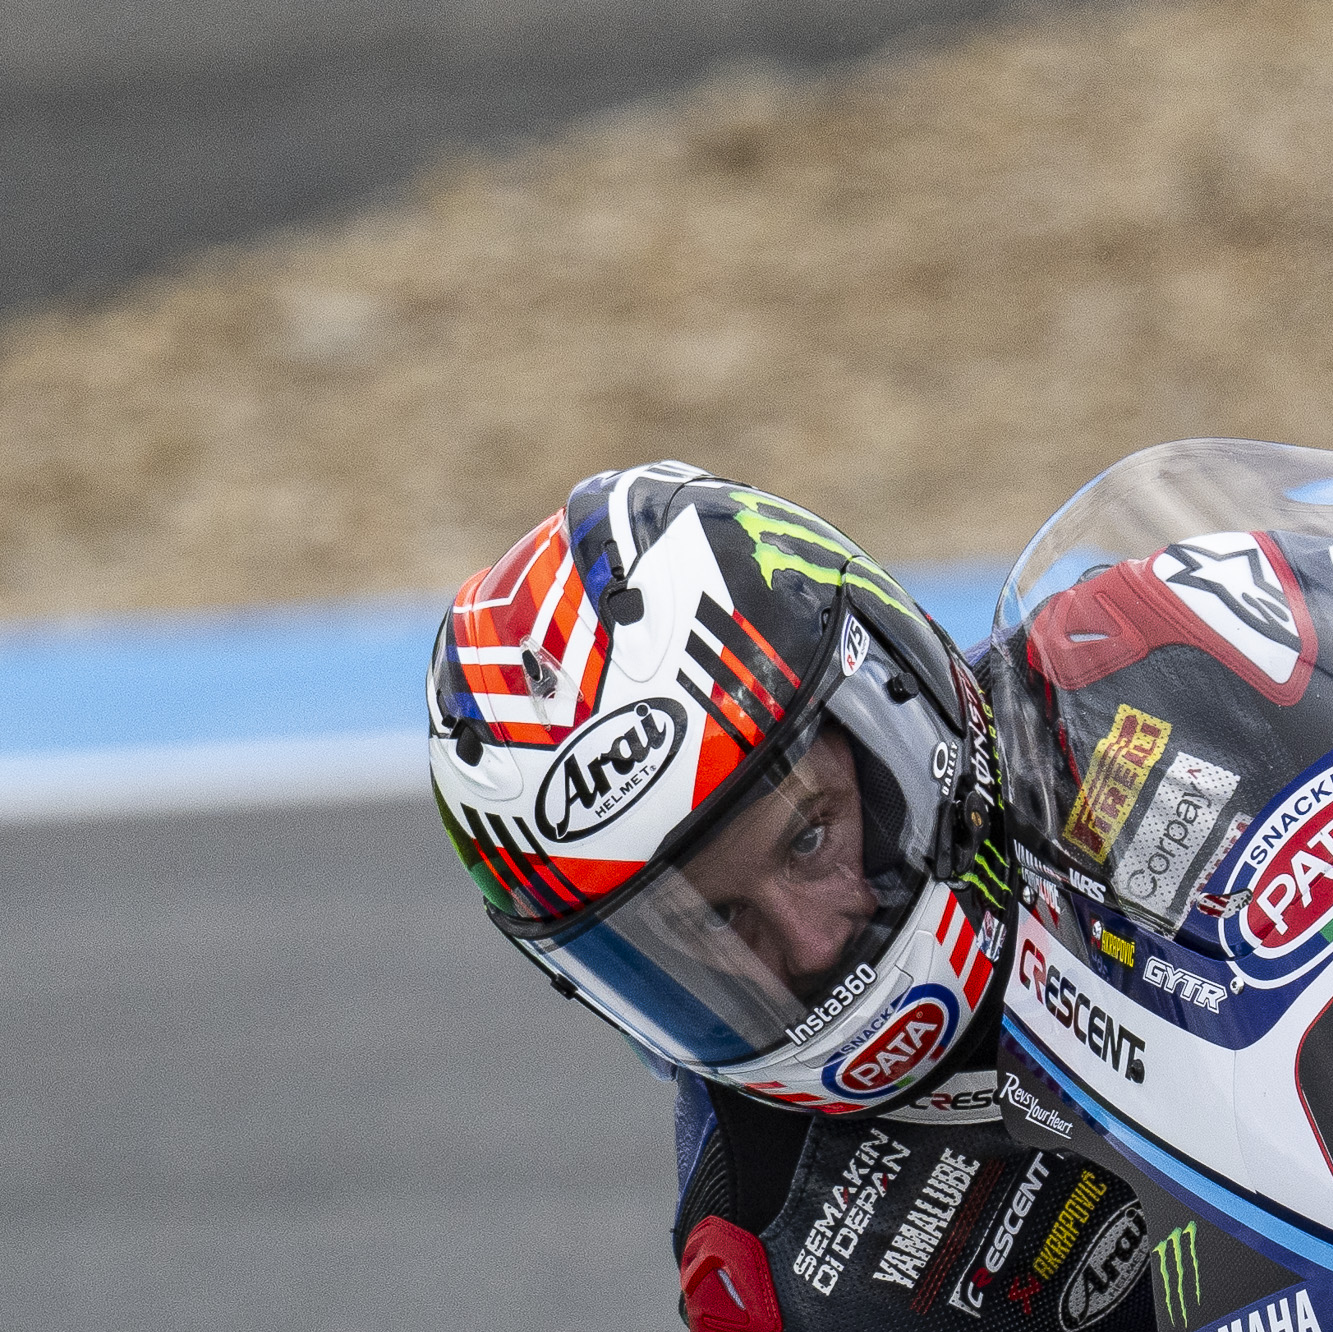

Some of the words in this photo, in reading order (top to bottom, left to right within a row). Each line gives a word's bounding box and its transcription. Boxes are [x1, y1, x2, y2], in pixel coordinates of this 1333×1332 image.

[556, 702, 669, 834] Arai
[594, 765, 651, 820] HELMET
[941, 742, 959, 797] OAKLEY
[1126, 785, 1214, 901] Corpay
[1250, 779, 1333, 866] SNACK
[1069, 867, 1107, 903] WRS
[784, 961, 879, 1048] Insta360
[1019, 938, 1146, 1085] CRESCENT
[1143, 956, 1228, 1014] GYTR
[840, 1006, 896, 1056] SNACK
[850, 1018, 939, 1090] PATA
[872, 1147, 981, 1289] YAMALUBE
[967, 1151, 1050, 1308] CRESCENT
[1075, 1206, 1148, 1326] Arai
